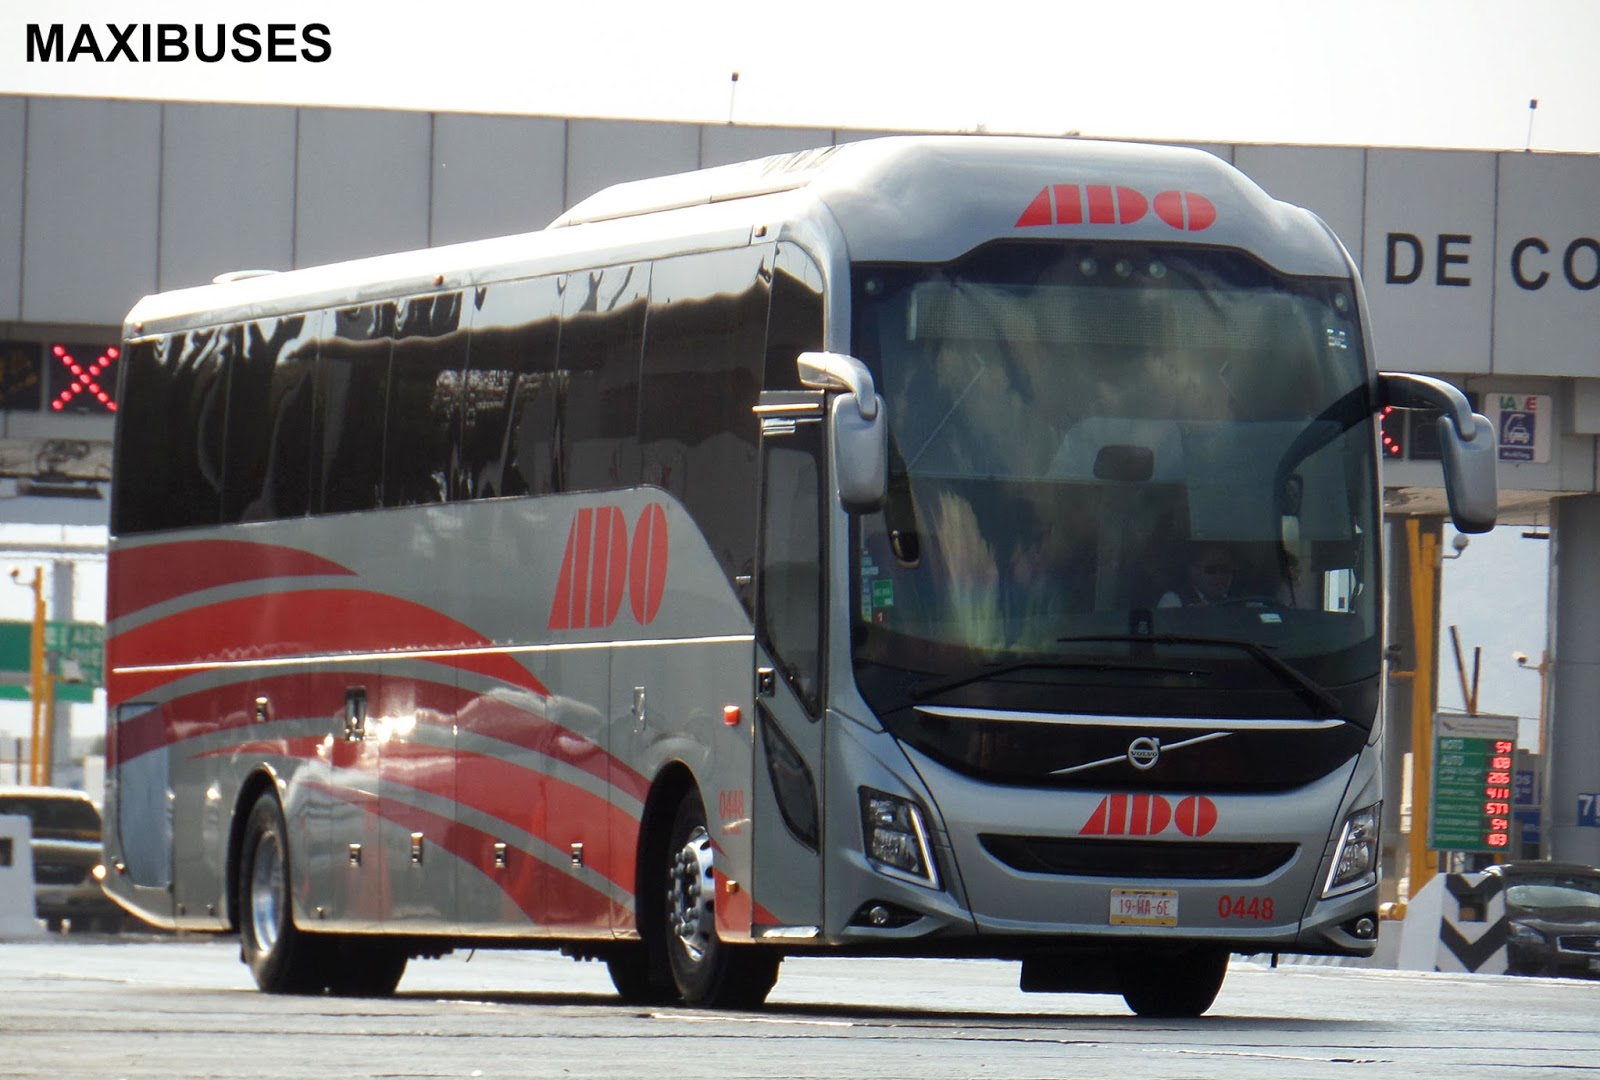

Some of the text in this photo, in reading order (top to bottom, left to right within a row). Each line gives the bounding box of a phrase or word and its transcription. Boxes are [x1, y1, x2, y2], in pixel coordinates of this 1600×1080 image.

[1014, 183, 1216, 231] ADO
[1386, 232, 1600, 290] DE CO
[547, 502, 669, 630] ADO
[1486, 788, 1510, 799] 411
[1487, 772, 1511, 784] 206
[1078, 793, 1218, 837] ADO
[1486, 802, 1509, 815] 577
[1218, 895, 1274, 921] 0448
